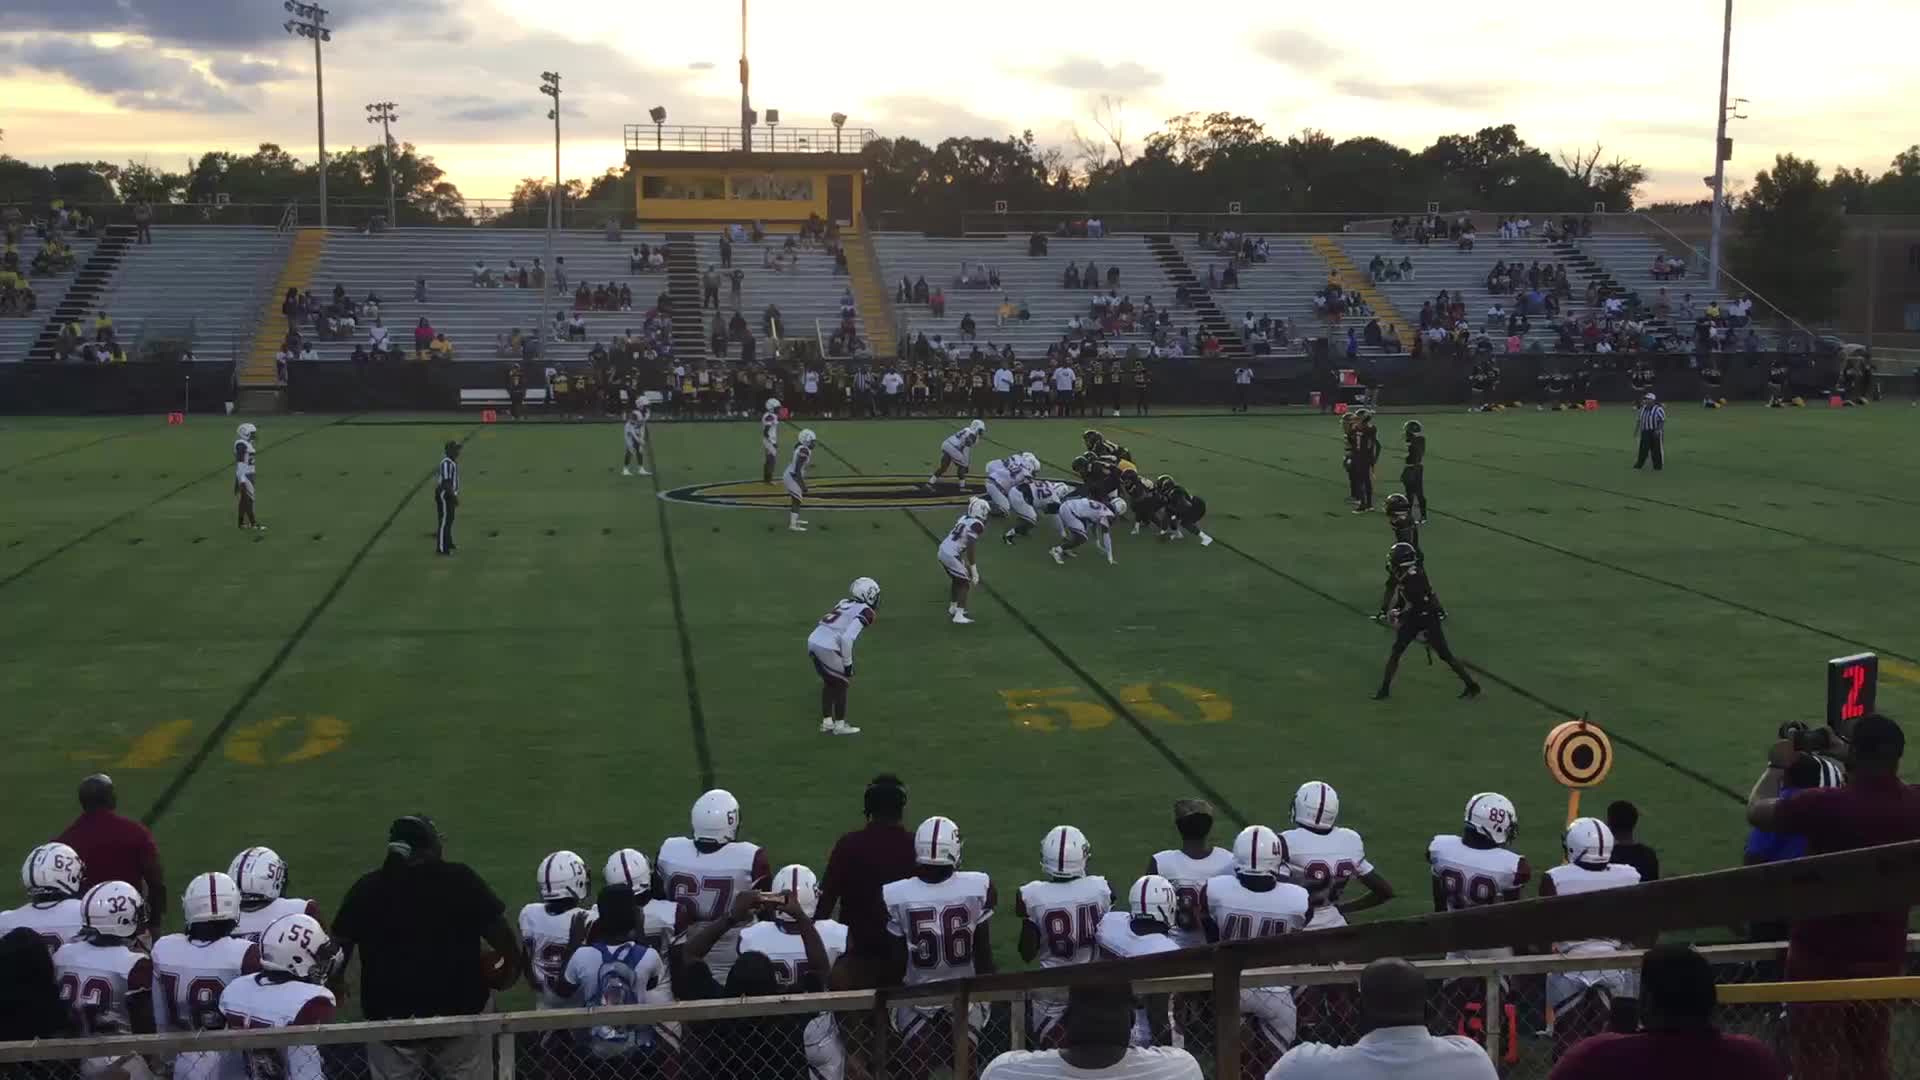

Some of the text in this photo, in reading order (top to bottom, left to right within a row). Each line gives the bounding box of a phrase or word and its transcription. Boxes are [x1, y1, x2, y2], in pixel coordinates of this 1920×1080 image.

[997, 681, 1233, 736] 50
[1841, 664, 1866, 720] 2
[1489, 808, 1506, 823] 89
[54, 855, 74, 872] 62
[268, 863, 285, 882] 50
[107, 895, 127, 914] 32
[670, 872, 735, 922] 67
[288, 924, 314, 948] 55
[906, 904, 973, 970] 56
[1042, 903, 1102, 960] 84
